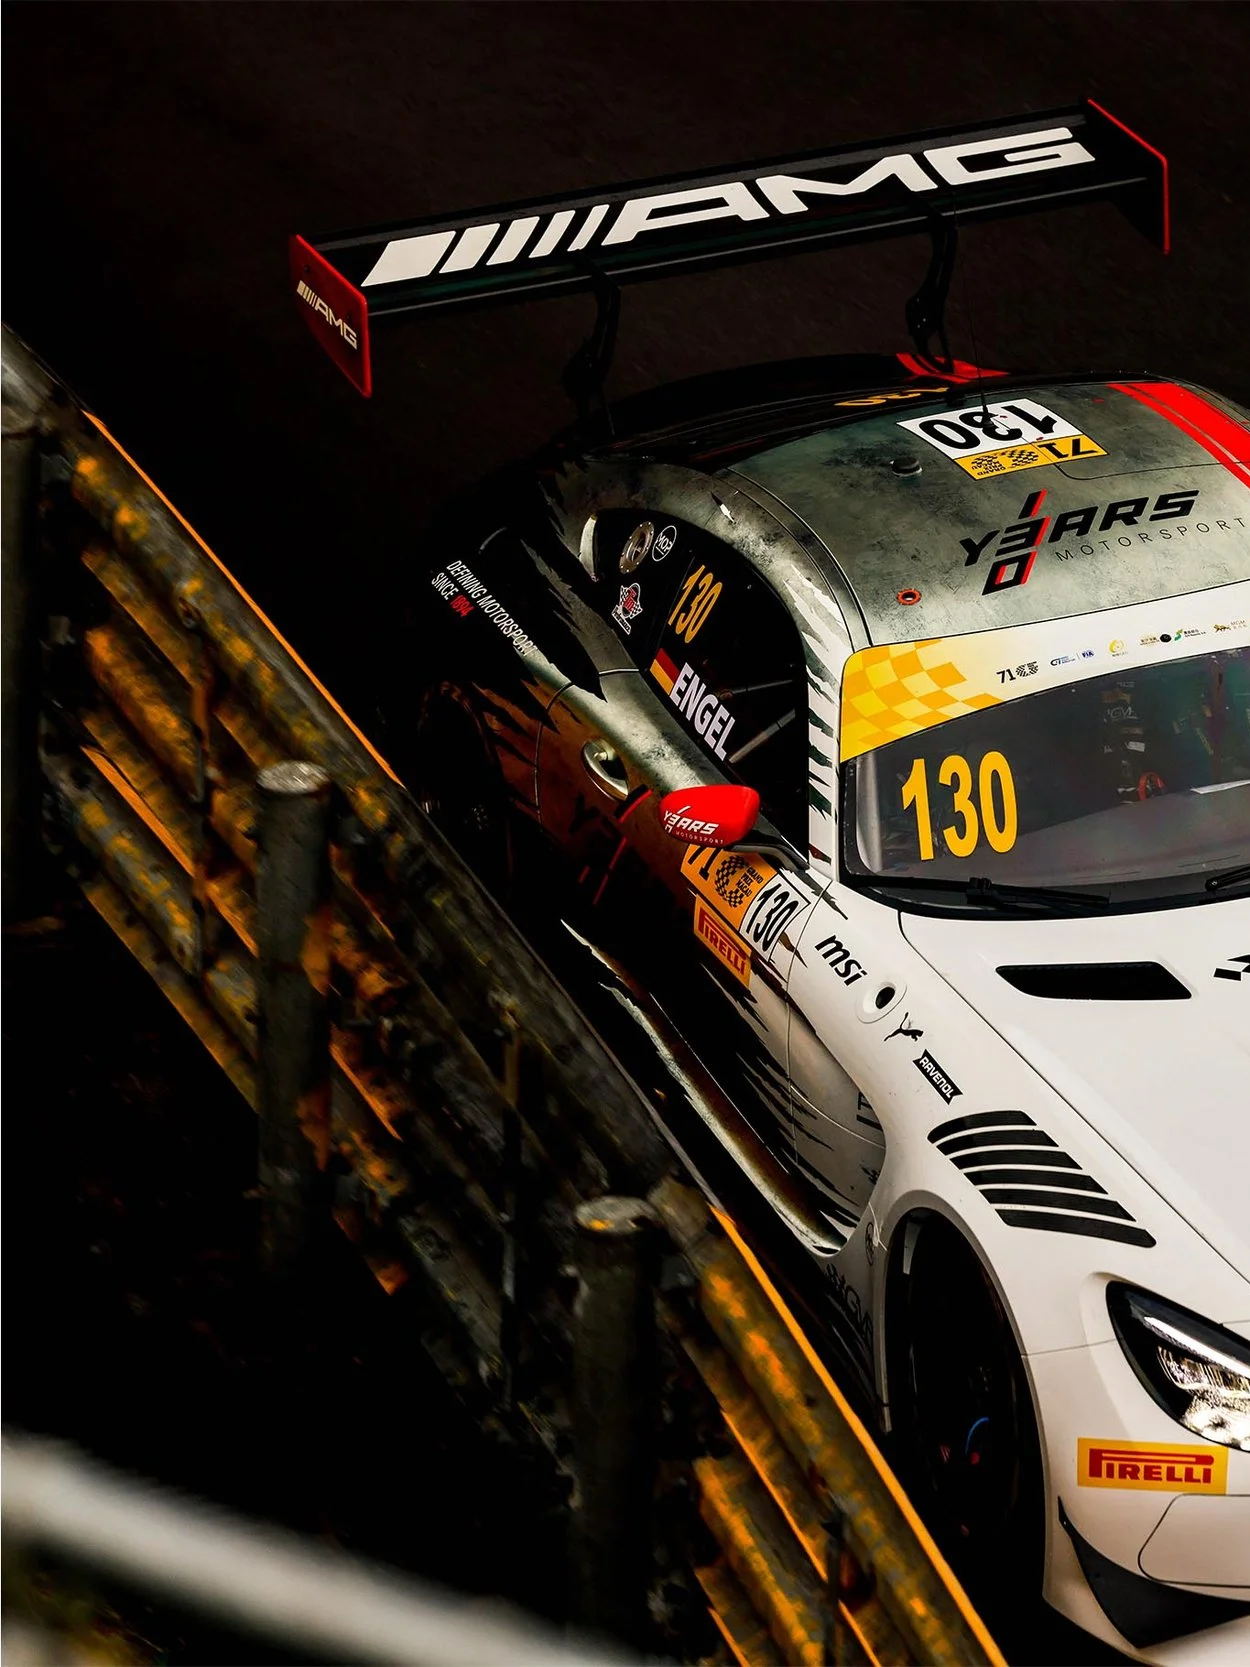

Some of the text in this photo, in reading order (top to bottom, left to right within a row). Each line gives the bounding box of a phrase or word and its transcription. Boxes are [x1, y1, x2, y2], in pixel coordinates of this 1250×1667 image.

[601, 127, 1096, 245] AMG
[315, 297, 357, 350] AMG
[919, 405, 1057, 450] 130
[1038, 438, 1098, 459] 71
[1055, 516, 1246, 562] MOTORSPORT
[431, 572, 459, 600] SINCE
[446, 560, 538, 657] DEFINING MOTORSPORT
[668, 565, 723, 644] 130
[669, 662, 735, 761] ENGEL
[902, 751, 1018, 862] 130
[745, 883, 800, 952] 130
[699, 912, 747, 977] PIRELLI
[814, 935, 868, 986] msi
[918, 1055, 955, 1099] RAVENOL
[1088, 1447, 1215, 1485] PIRELLI
